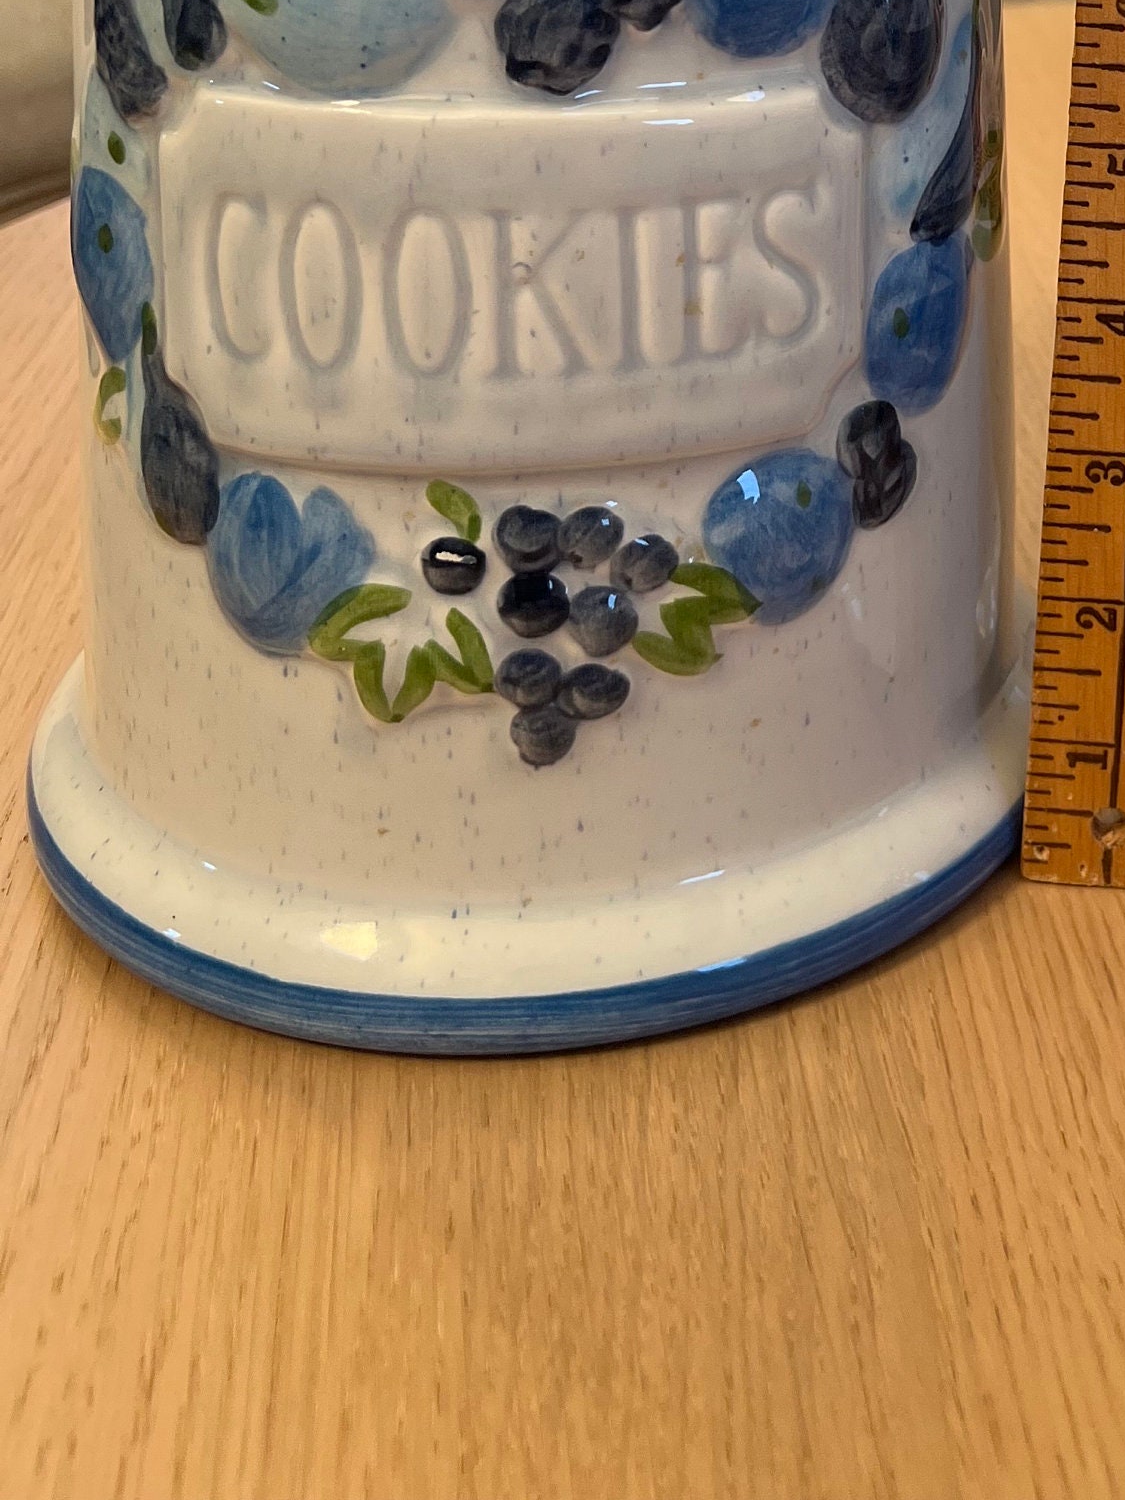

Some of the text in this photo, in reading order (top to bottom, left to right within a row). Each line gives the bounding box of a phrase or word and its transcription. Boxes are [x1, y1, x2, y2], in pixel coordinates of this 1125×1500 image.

[204, 186, 828, 379] COOKIES
[1075, 605, 1118, 633] 2
[1065, 747, 1109, 771] 1
